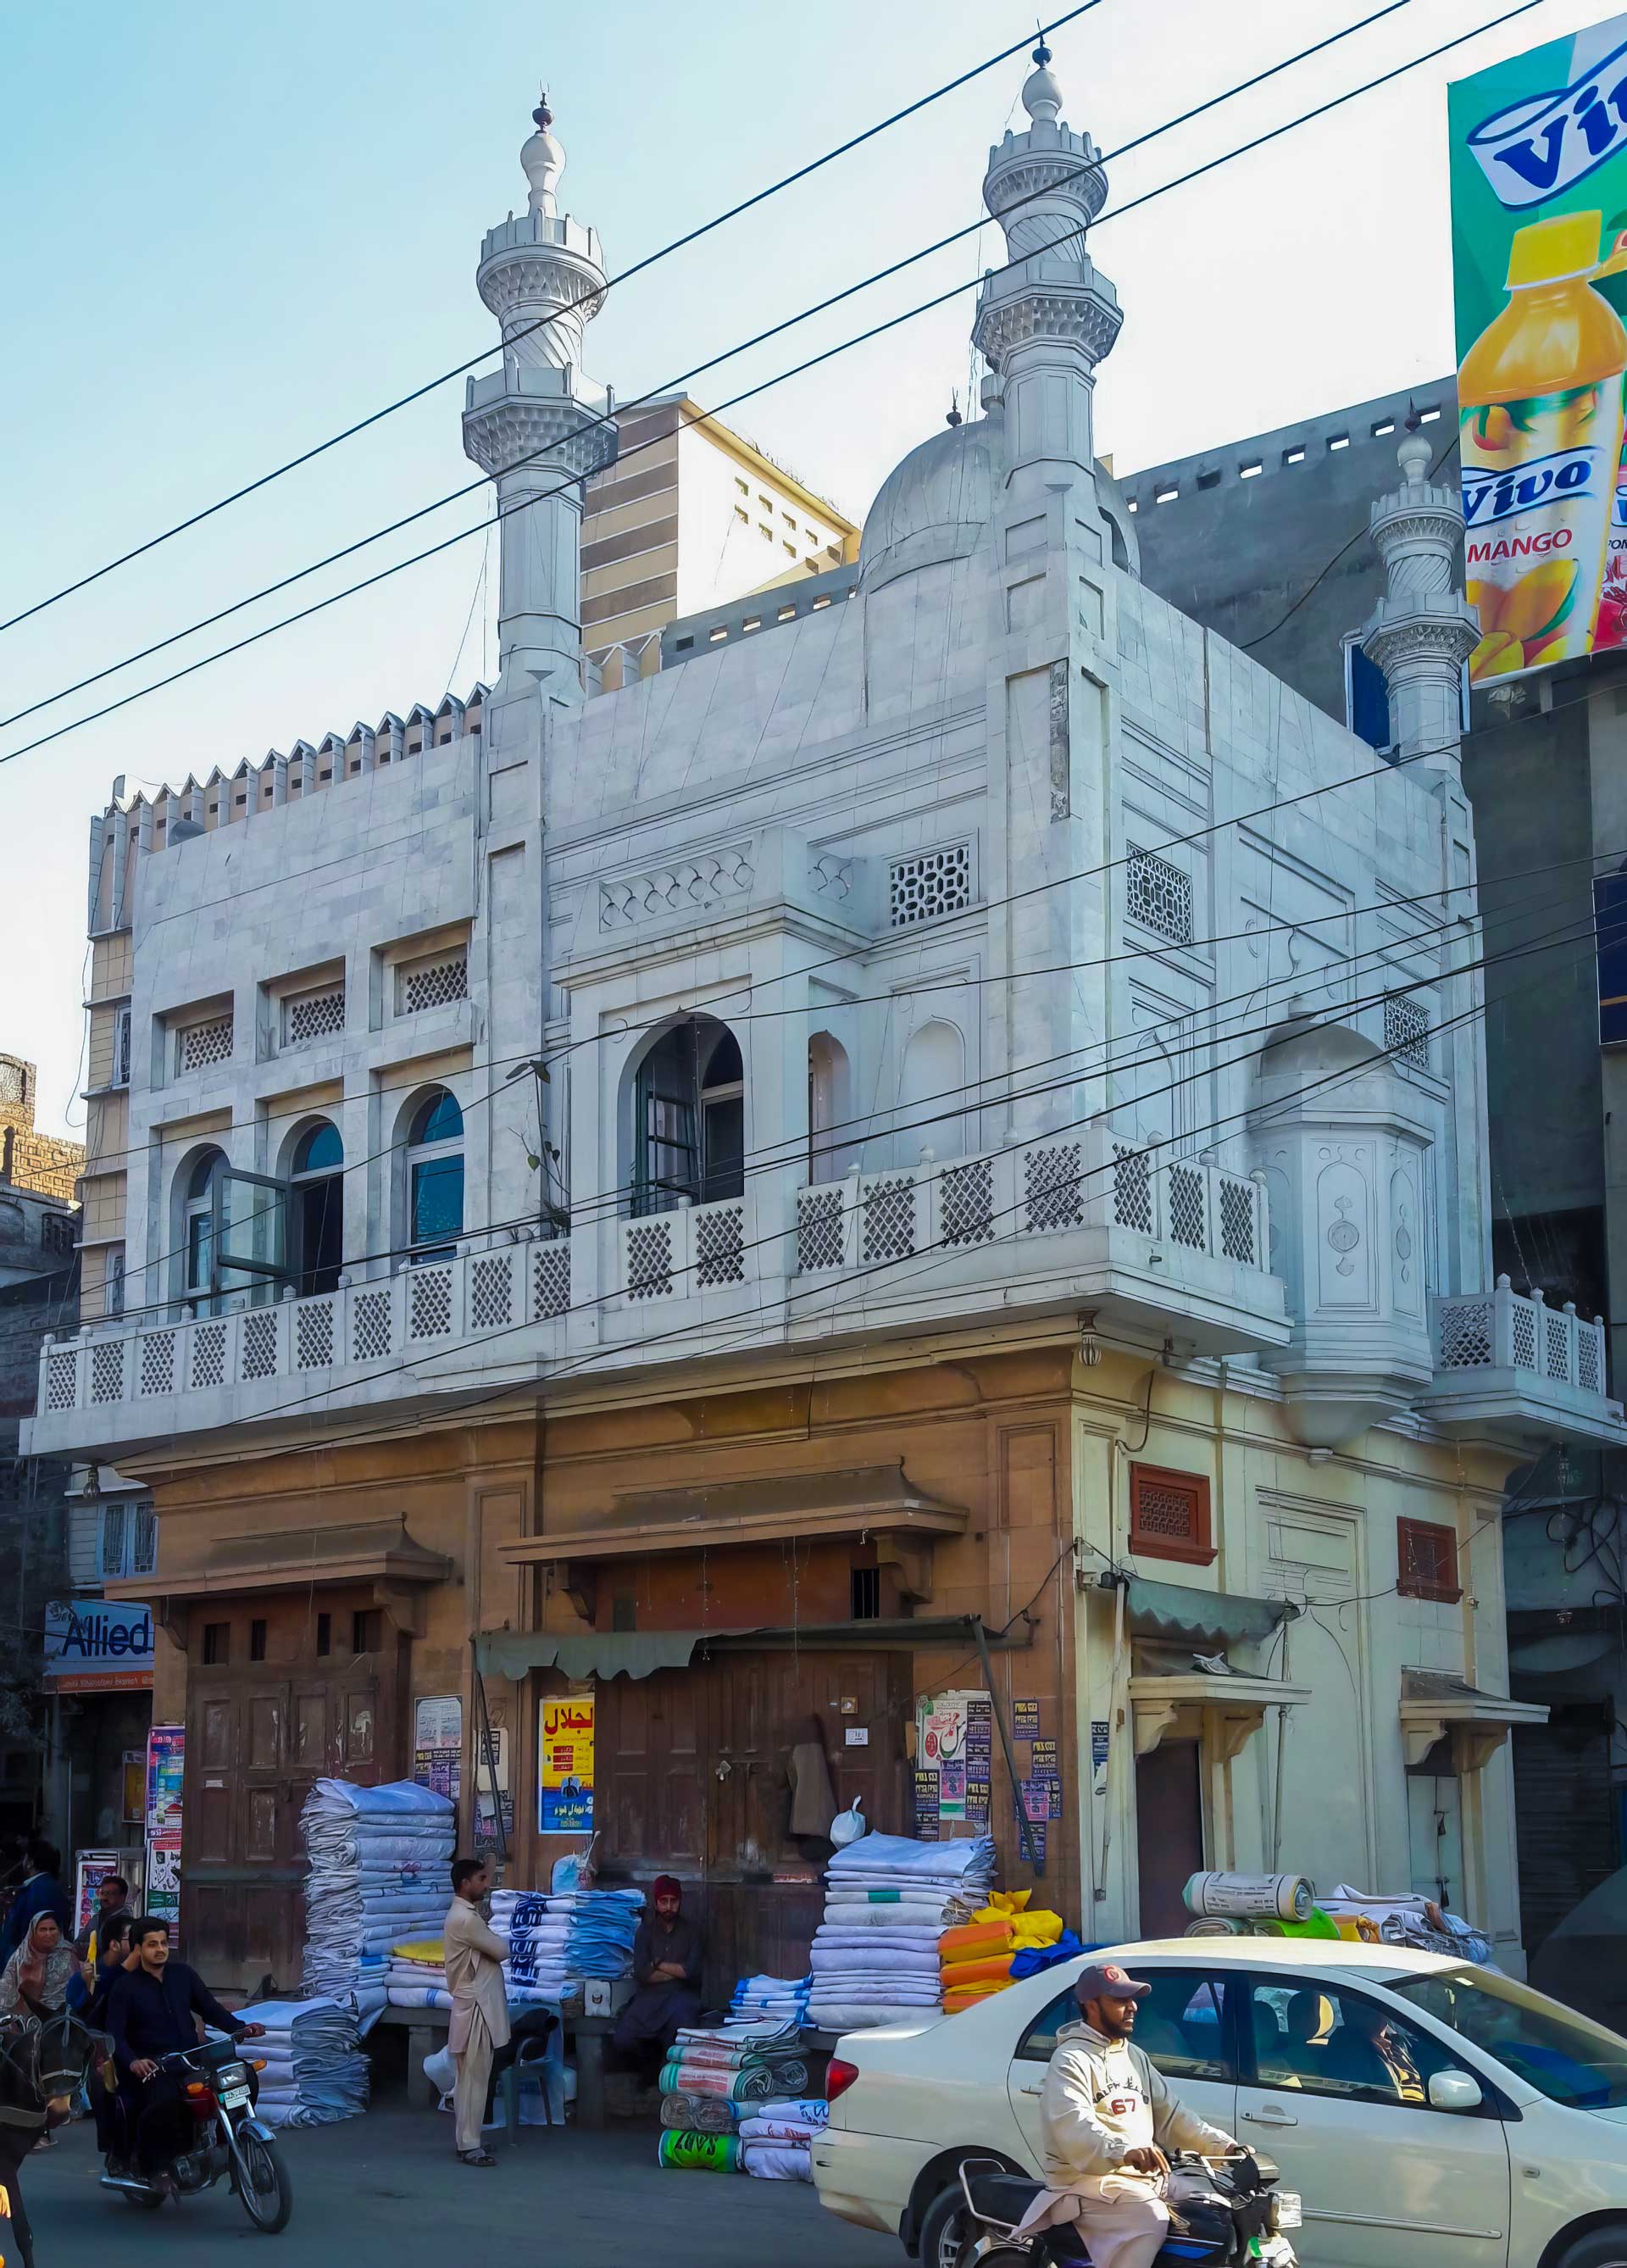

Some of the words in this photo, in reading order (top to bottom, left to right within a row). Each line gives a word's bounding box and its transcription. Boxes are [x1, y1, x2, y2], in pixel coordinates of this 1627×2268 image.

[1493, 75, 1627, 189] Vi
[1467, 528, 1573, 564] MANGO
[62, 1612, 149, 1657] Allied
[1111, 2098, 1136, 2115] 67
